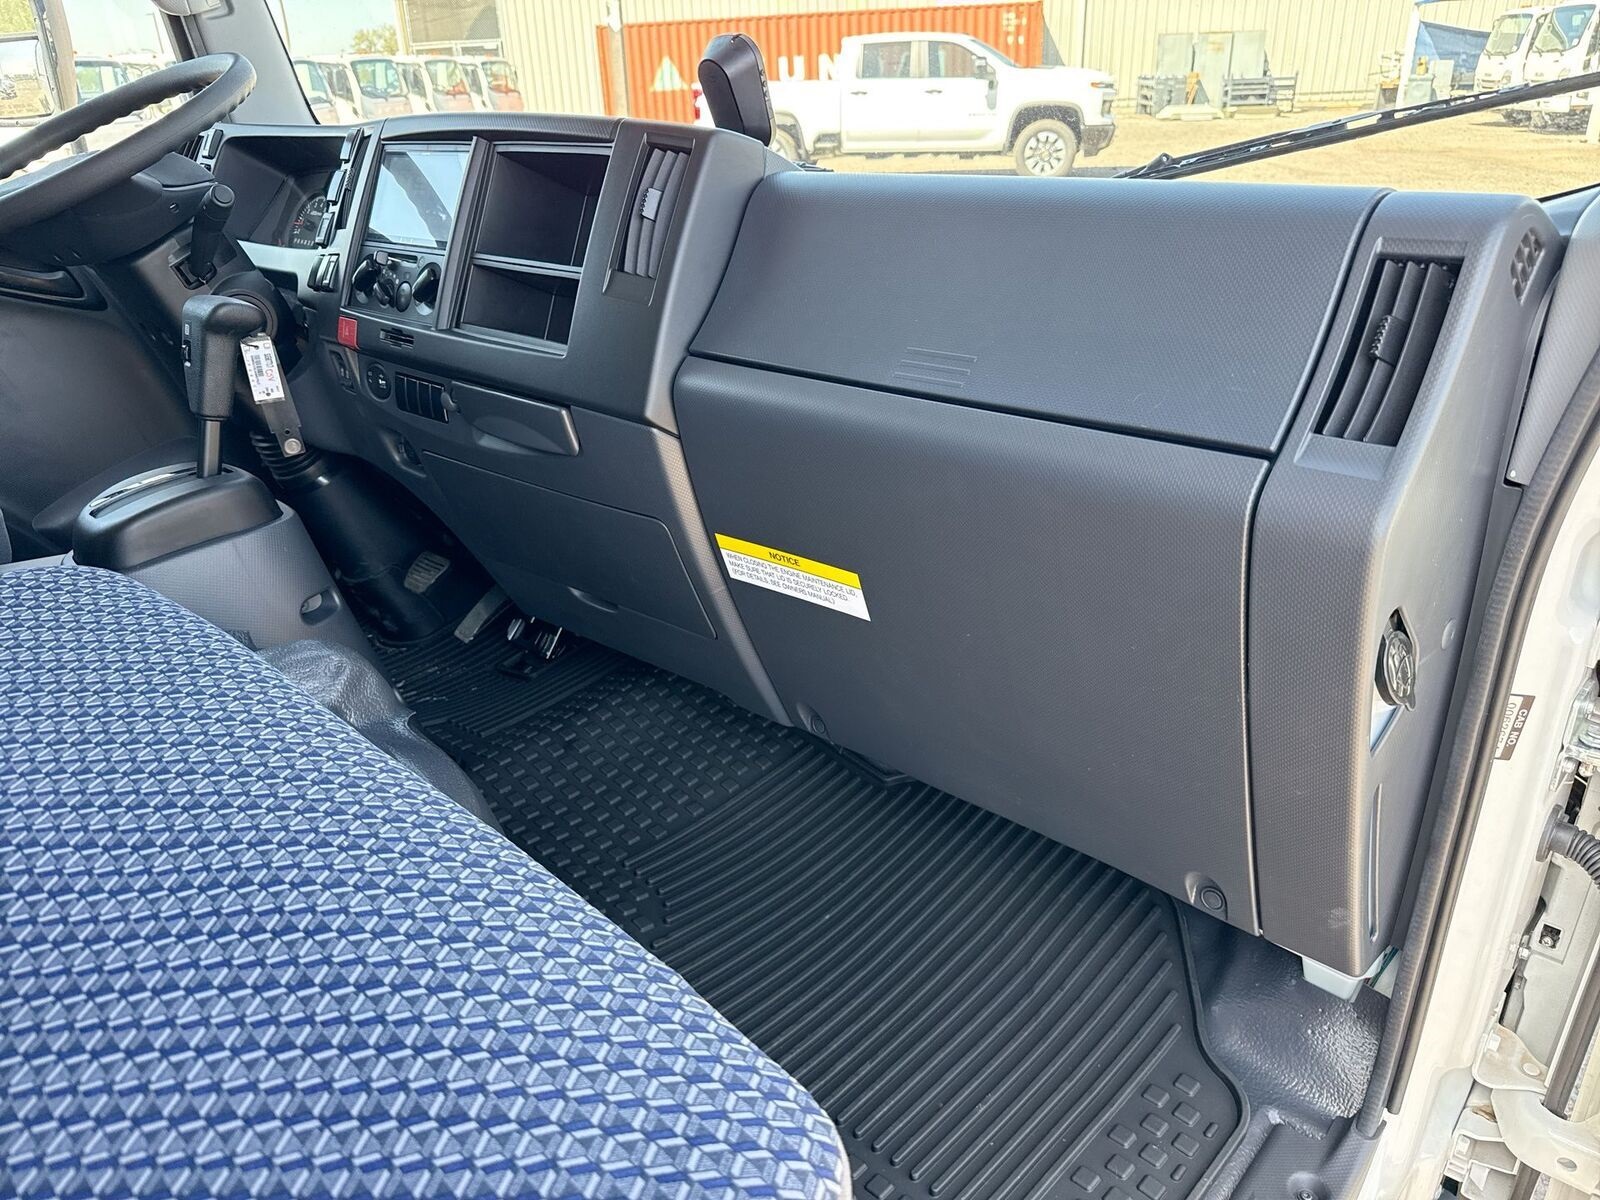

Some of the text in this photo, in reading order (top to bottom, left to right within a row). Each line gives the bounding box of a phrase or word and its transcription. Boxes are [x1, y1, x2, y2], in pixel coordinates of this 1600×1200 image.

[726, 552, 743, 562] WHEN
[743, 558, 767, 569] CLOSING
[780, 569, 801, 579] ENGINE
[802, 575, 844, 592] MAINTENANCE
[729, 560, 745, 569] MAKE
[745, 565, 760, 574] SURE
[762, 570, 776, 578] THAT
[793, 579, 822, 593] SECURELY
[769, 552, 800, 566] NOTICE
[1506, 709, 1528, 747] CAB NO.
